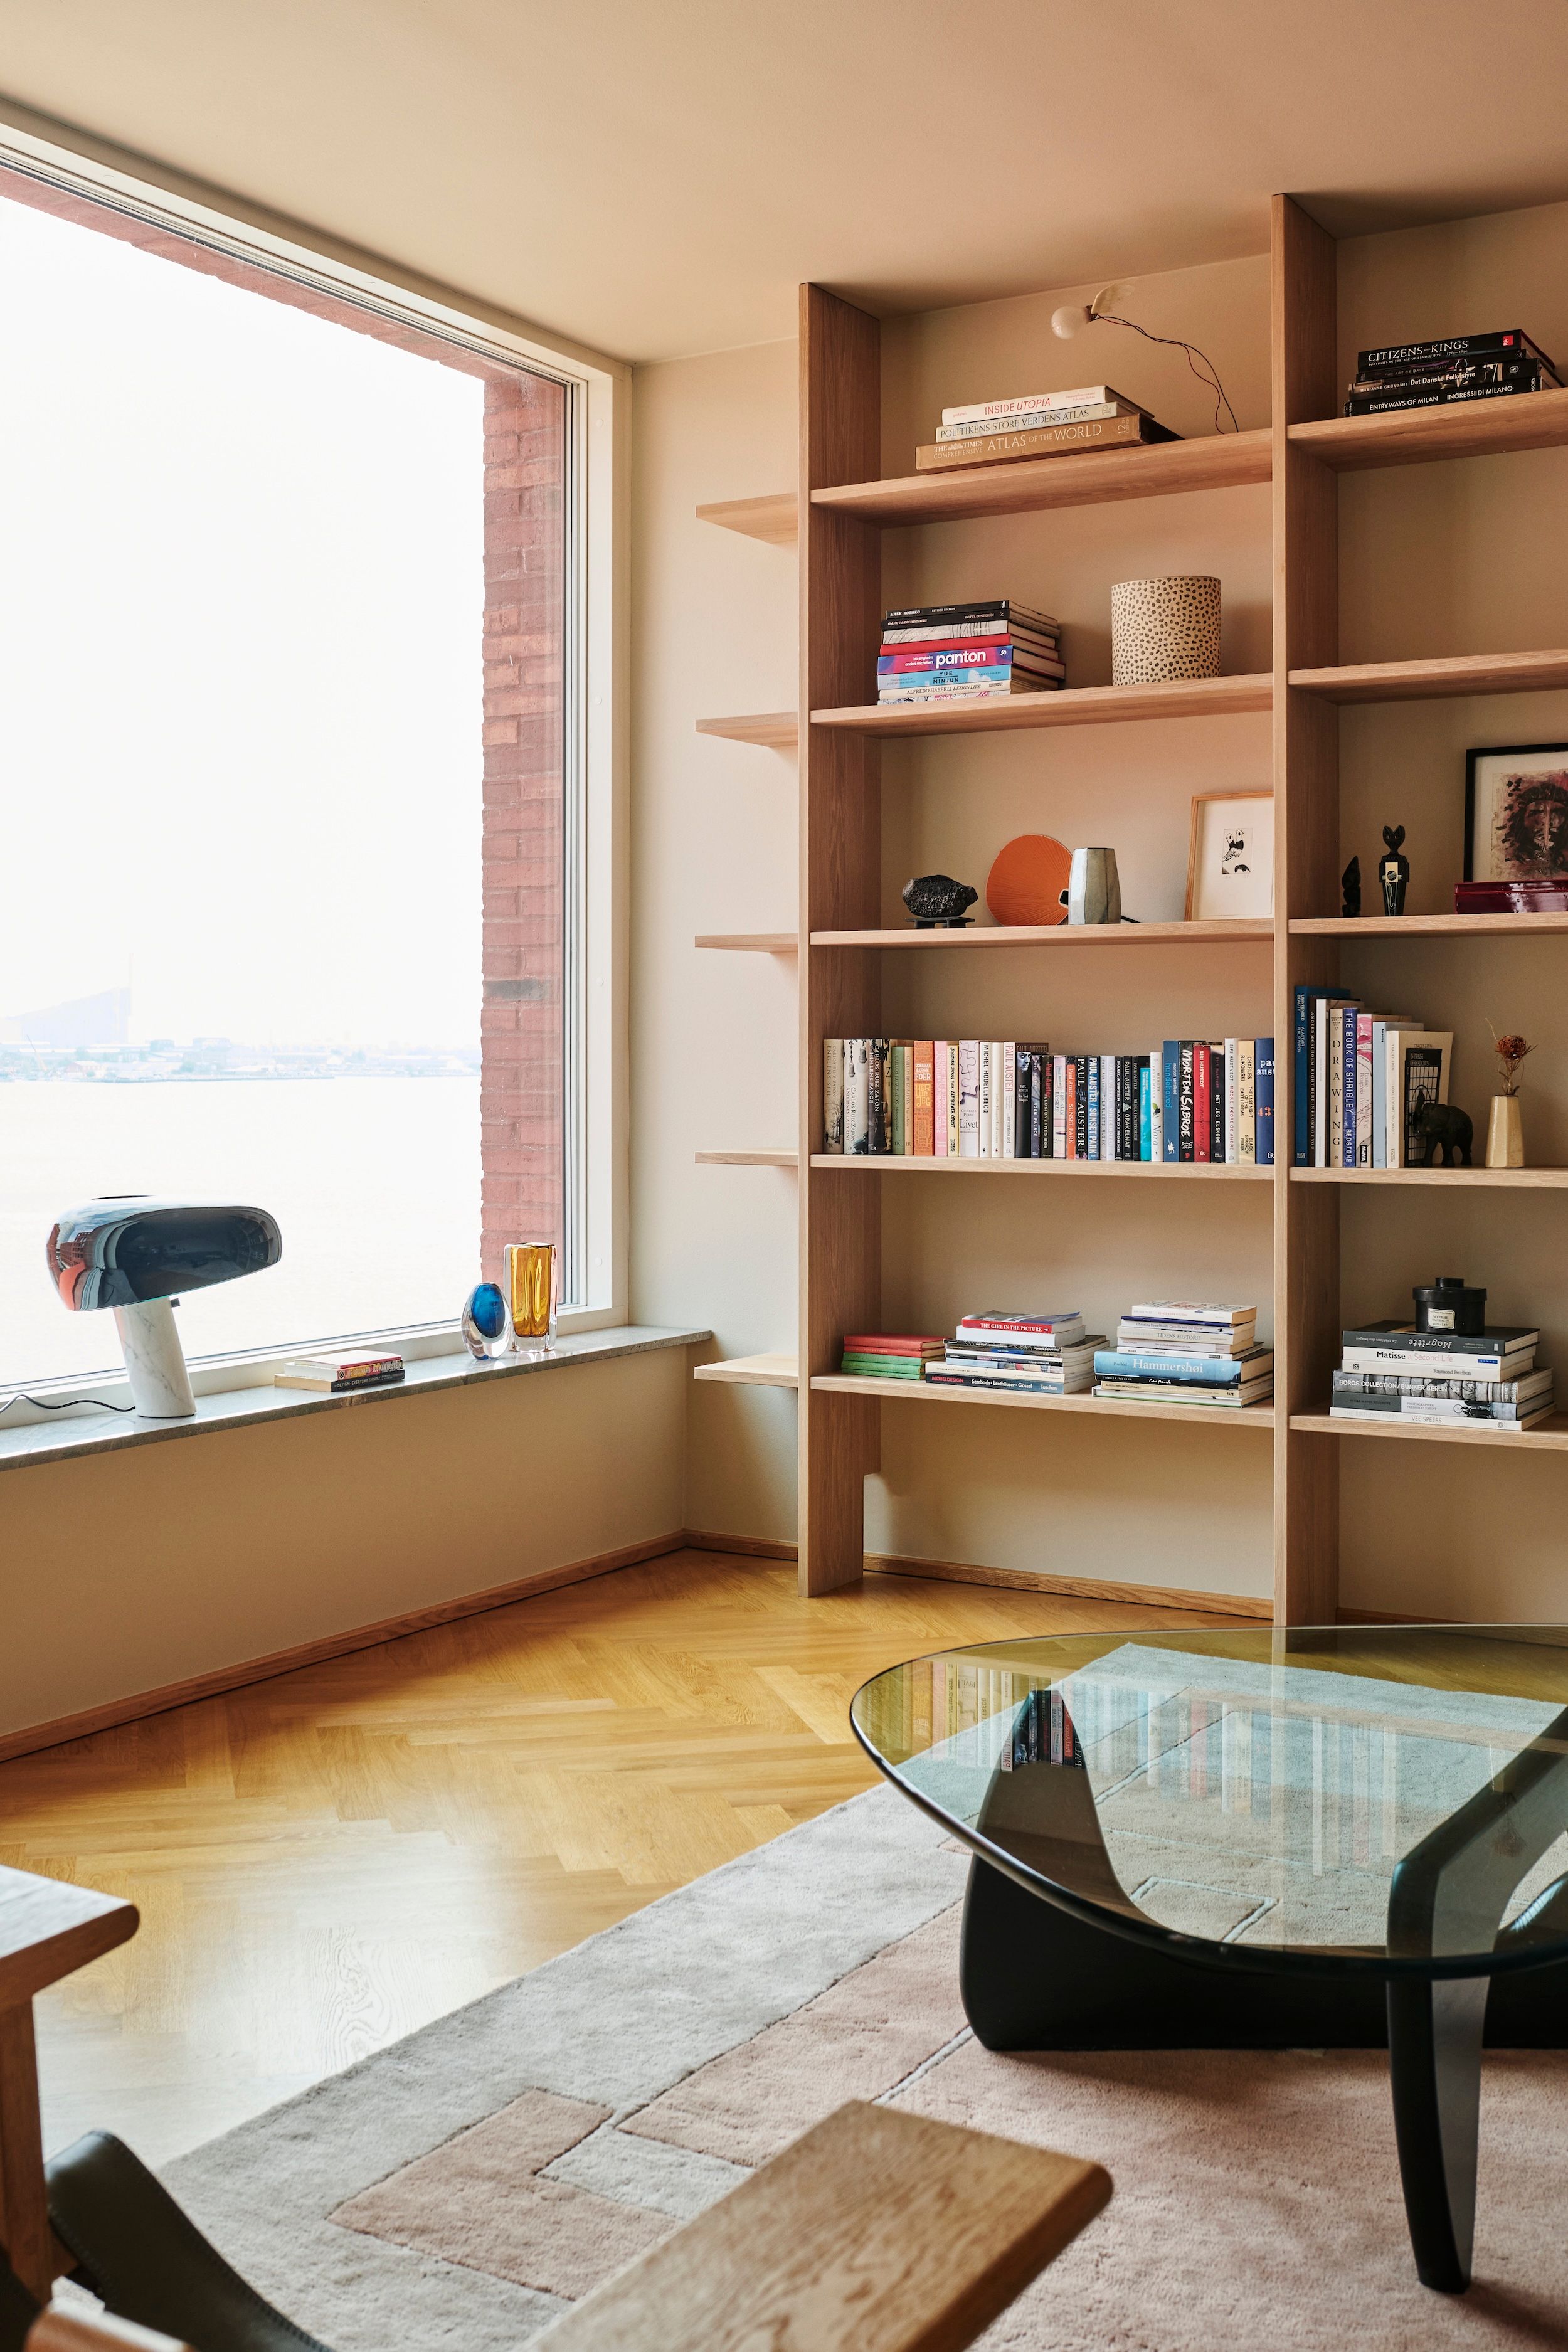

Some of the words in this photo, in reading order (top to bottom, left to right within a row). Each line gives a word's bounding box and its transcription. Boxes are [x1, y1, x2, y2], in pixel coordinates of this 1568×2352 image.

[1368, 346, 1423, 362] CITIZENS
[1431, 341, 1468, 353] KINGS
[1360, 384, 1382, 393] MARIANNE
[1422, 376, 1444, 384] Danske
[1445, 372, 1476, 381] Folkestyre
[985, 403, 1015, 415] INSIDE
[1017, 398, 1051, 410] UTOPIA
[1369, 400, 1406, 411] ENTRYWAYS
[1417, 395, 1439, 405] MILAN
[1446, 390, 1476, 400] INGRESSI
[1485, 384, 1513, 395] MILANO
[941, 425, 990, 438] POLITIKENS
[992, 419, 1019, 430] STORE
[1022, 413, 1061, 426] VERDENS
[1062, 409, 1089, 421] ATLAS
[963, 440, 983, 448] TIMES
[987, 434, 1026, 452] ATLAS
[1039, 433, 1053, 442] THE
[1054, 424, 1102, 442] WORLD
[933, 447, 983, 460] COMPREHENSIVE
[936, 650, 986, 669] panton
[1005, 1046, 1014, 1062] PAUL
[1345, 1058, 1353, 1068] OF
[1005, 1065, 1014, 1092] AUSTER
[1077, 1058, 1085, 1086] PAUL
[1182, 1049, 1193, 1096] MORTEN
[1332, 1039, 1342, 1146] DRAWING
[1345, 1072, 1353, 1114] SHRIGLEY
[960, 1119, 978, 1128] Livet
[1077, 1103, 1085, 1147] AUSTER
[1180, 1095, 1192, 1137] SABROE
[1152, 1125, 1162, 1146] Nora
[1409, 1339, 1452, 1349] Magritte
[1133, 1358, 1203, 1373] Hammershøi
[1377, 1351, 1406, 1359] Matisse
[1414, 1353, 1439, 1362] Second
[1441, 1354, 1453, 1362] Life
